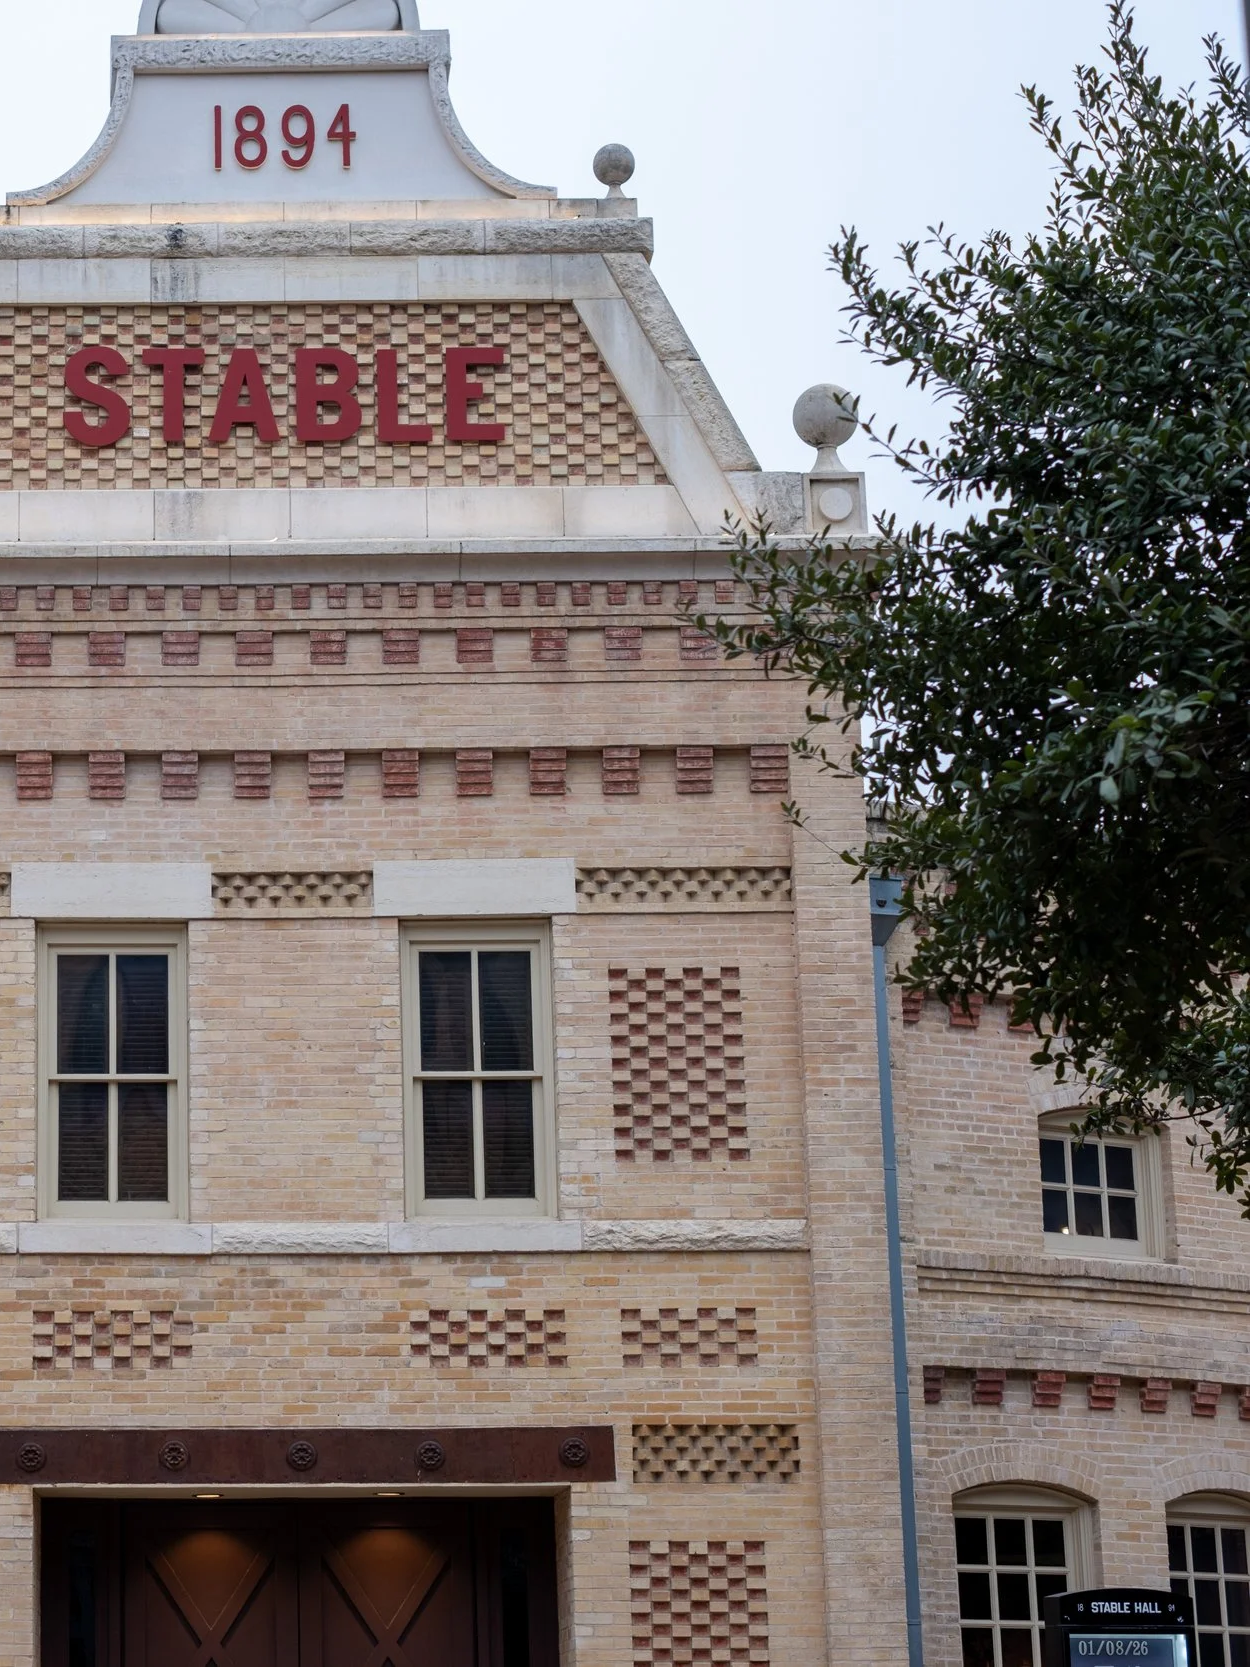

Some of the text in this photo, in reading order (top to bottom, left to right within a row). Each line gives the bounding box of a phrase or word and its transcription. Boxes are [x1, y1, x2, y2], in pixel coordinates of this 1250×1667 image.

[213, 103, 357, 171] 1894
[62, 345, 506, 448] STABLE
[1077, 1603, 1084, 1612] 18
[1091, 1602, 1131, 1614] STABLE
[1134, 1602, 1161, 1614] HALL
[1078, 1640, 1148, 1656] 01/08/26
